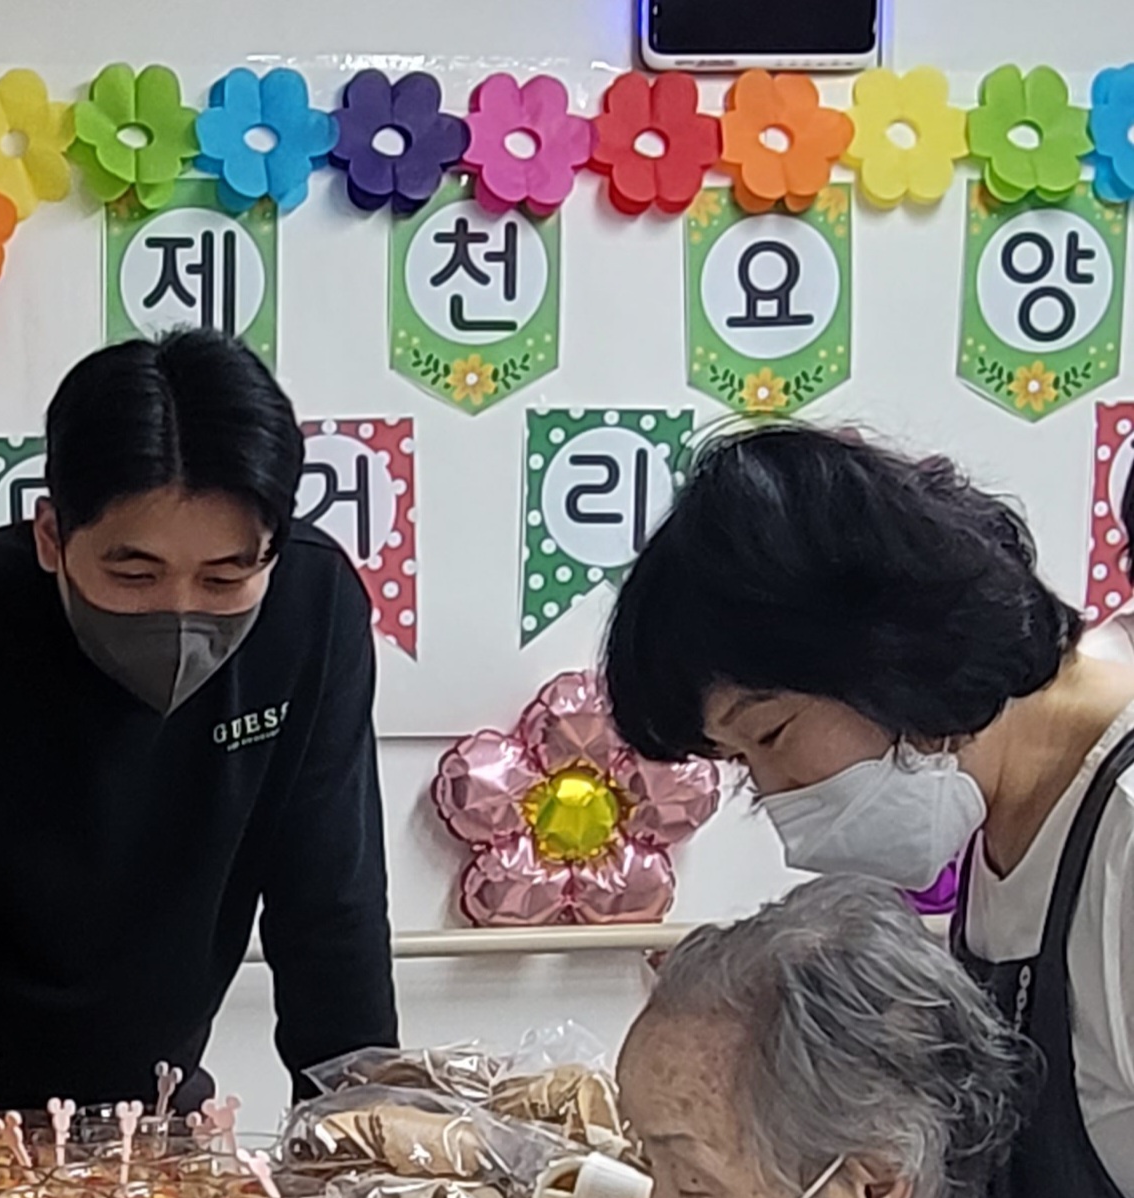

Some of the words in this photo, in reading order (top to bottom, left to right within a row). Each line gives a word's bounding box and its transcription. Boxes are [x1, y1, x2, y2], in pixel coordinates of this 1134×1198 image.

[142, 230, 236, 337] 제
[429, 217, 518, 331] 천
[725, 240, 815, 329] 요
[1000, 230, 1096, 342] 양
[564, 447, 648, 554] 리
